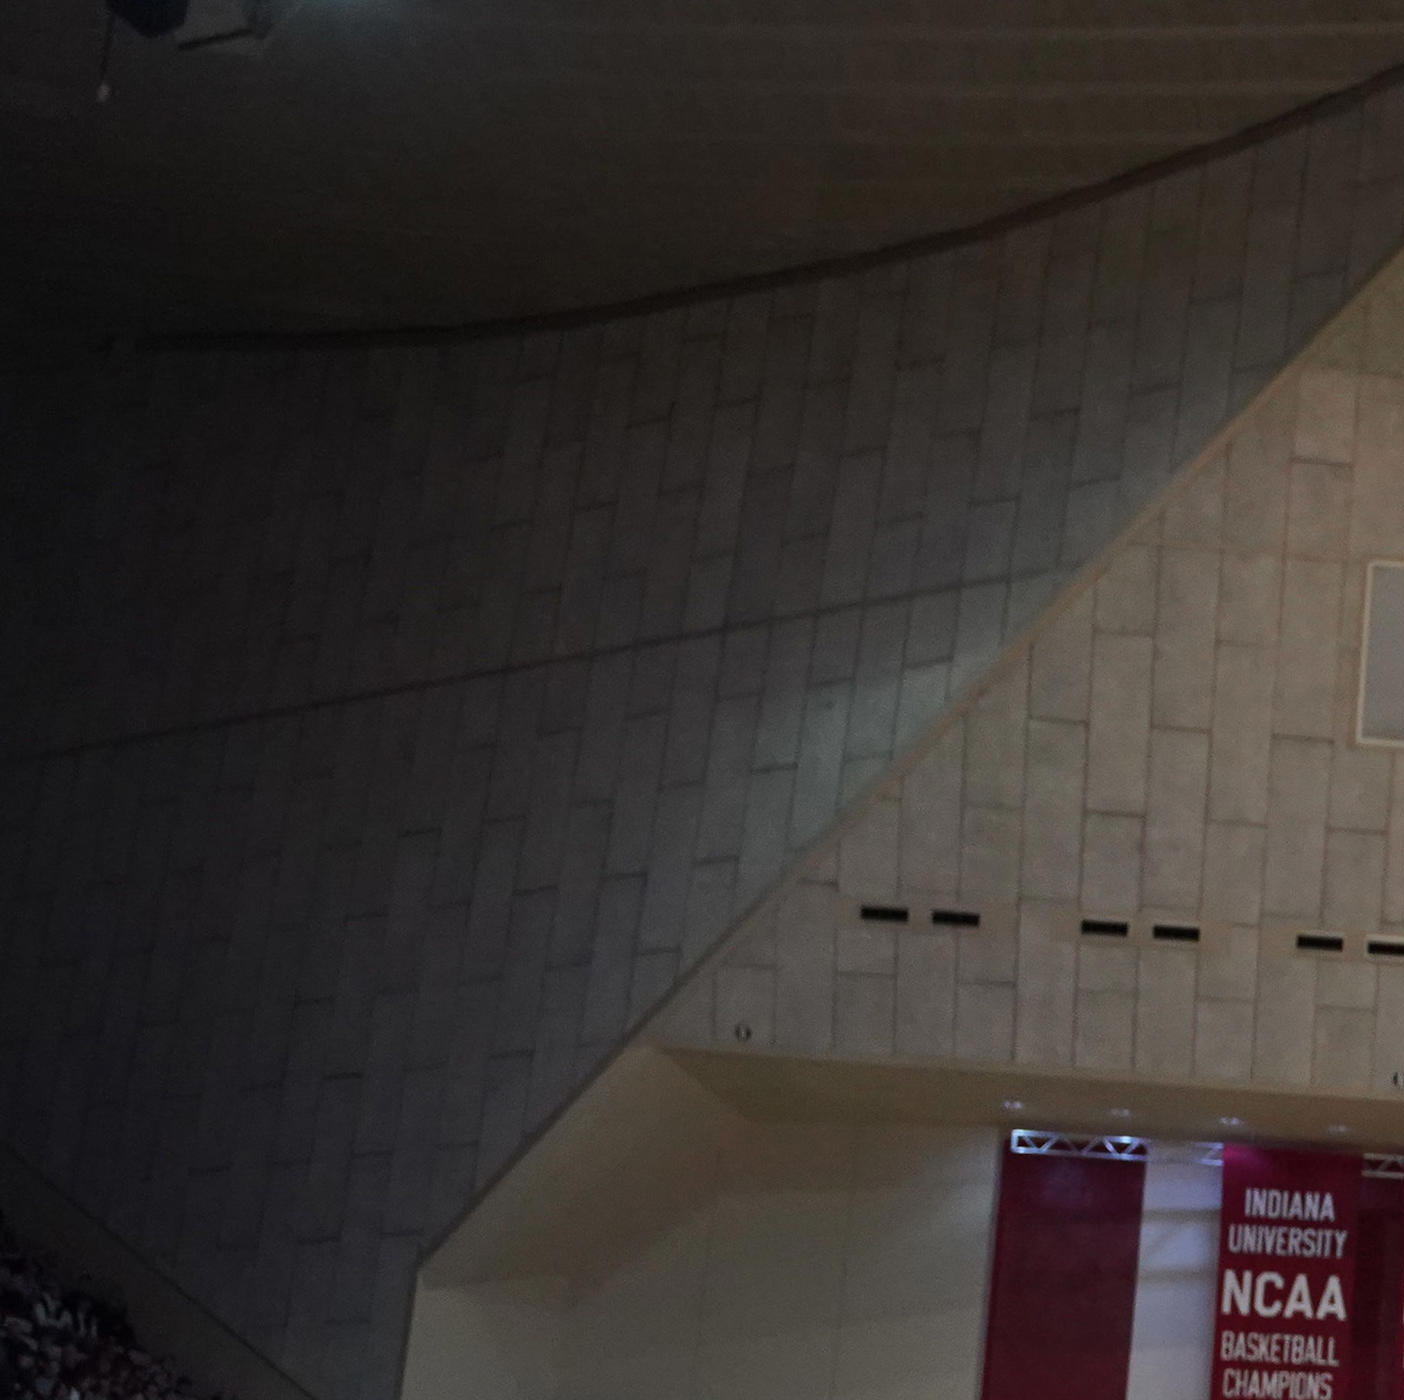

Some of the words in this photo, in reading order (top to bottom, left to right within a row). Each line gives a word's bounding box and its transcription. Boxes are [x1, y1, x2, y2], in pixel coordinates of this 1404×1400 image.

[1244, 1187, 1336, 1223] INDIANA
[1227, 1224, 1348, 1260] UNIVERSITY
[1221, 1268, 1347, 1322] NCAA
[1220, 1330, 1340, 1367] BASKETBALL
